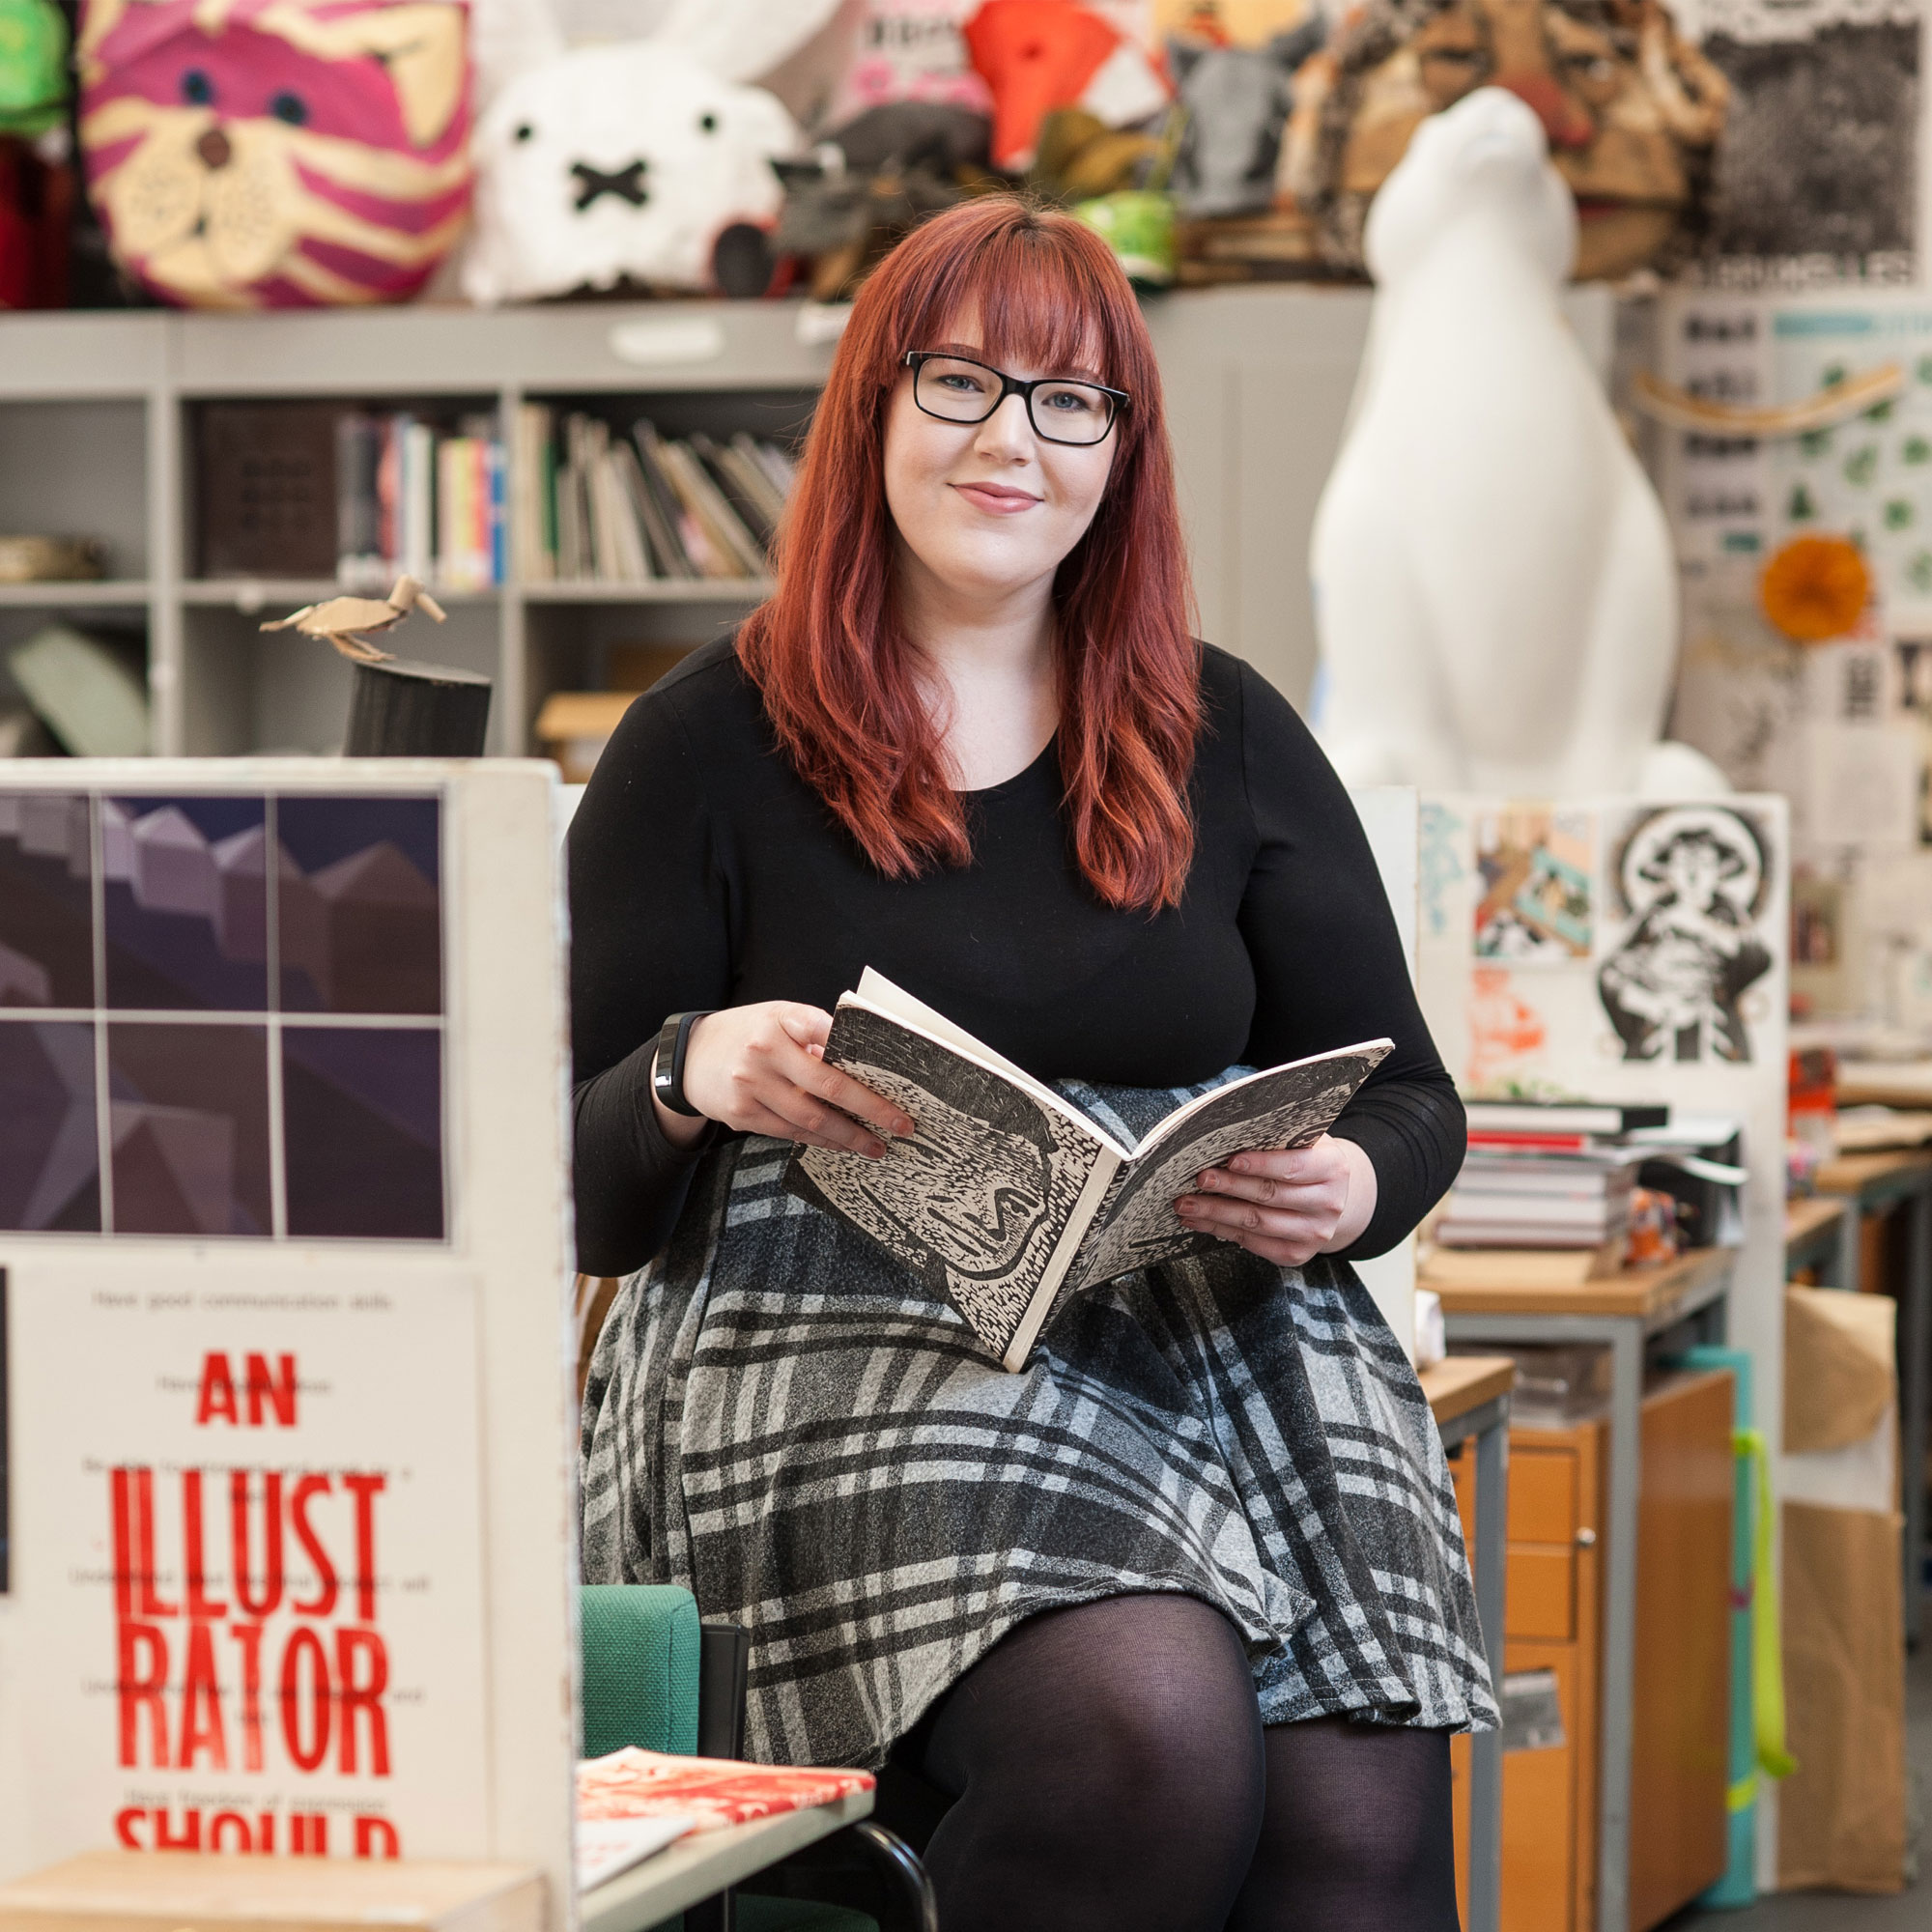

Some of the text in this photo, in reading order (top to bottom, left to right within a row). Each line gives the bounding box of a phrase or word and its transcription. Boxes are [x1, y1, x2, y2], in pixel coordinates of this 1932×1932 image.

[194, 1350, 298, 1429] AN
[108, 1465, 388, 1622] ILLUST
[115, 1619, 393, 1779] RATOR
